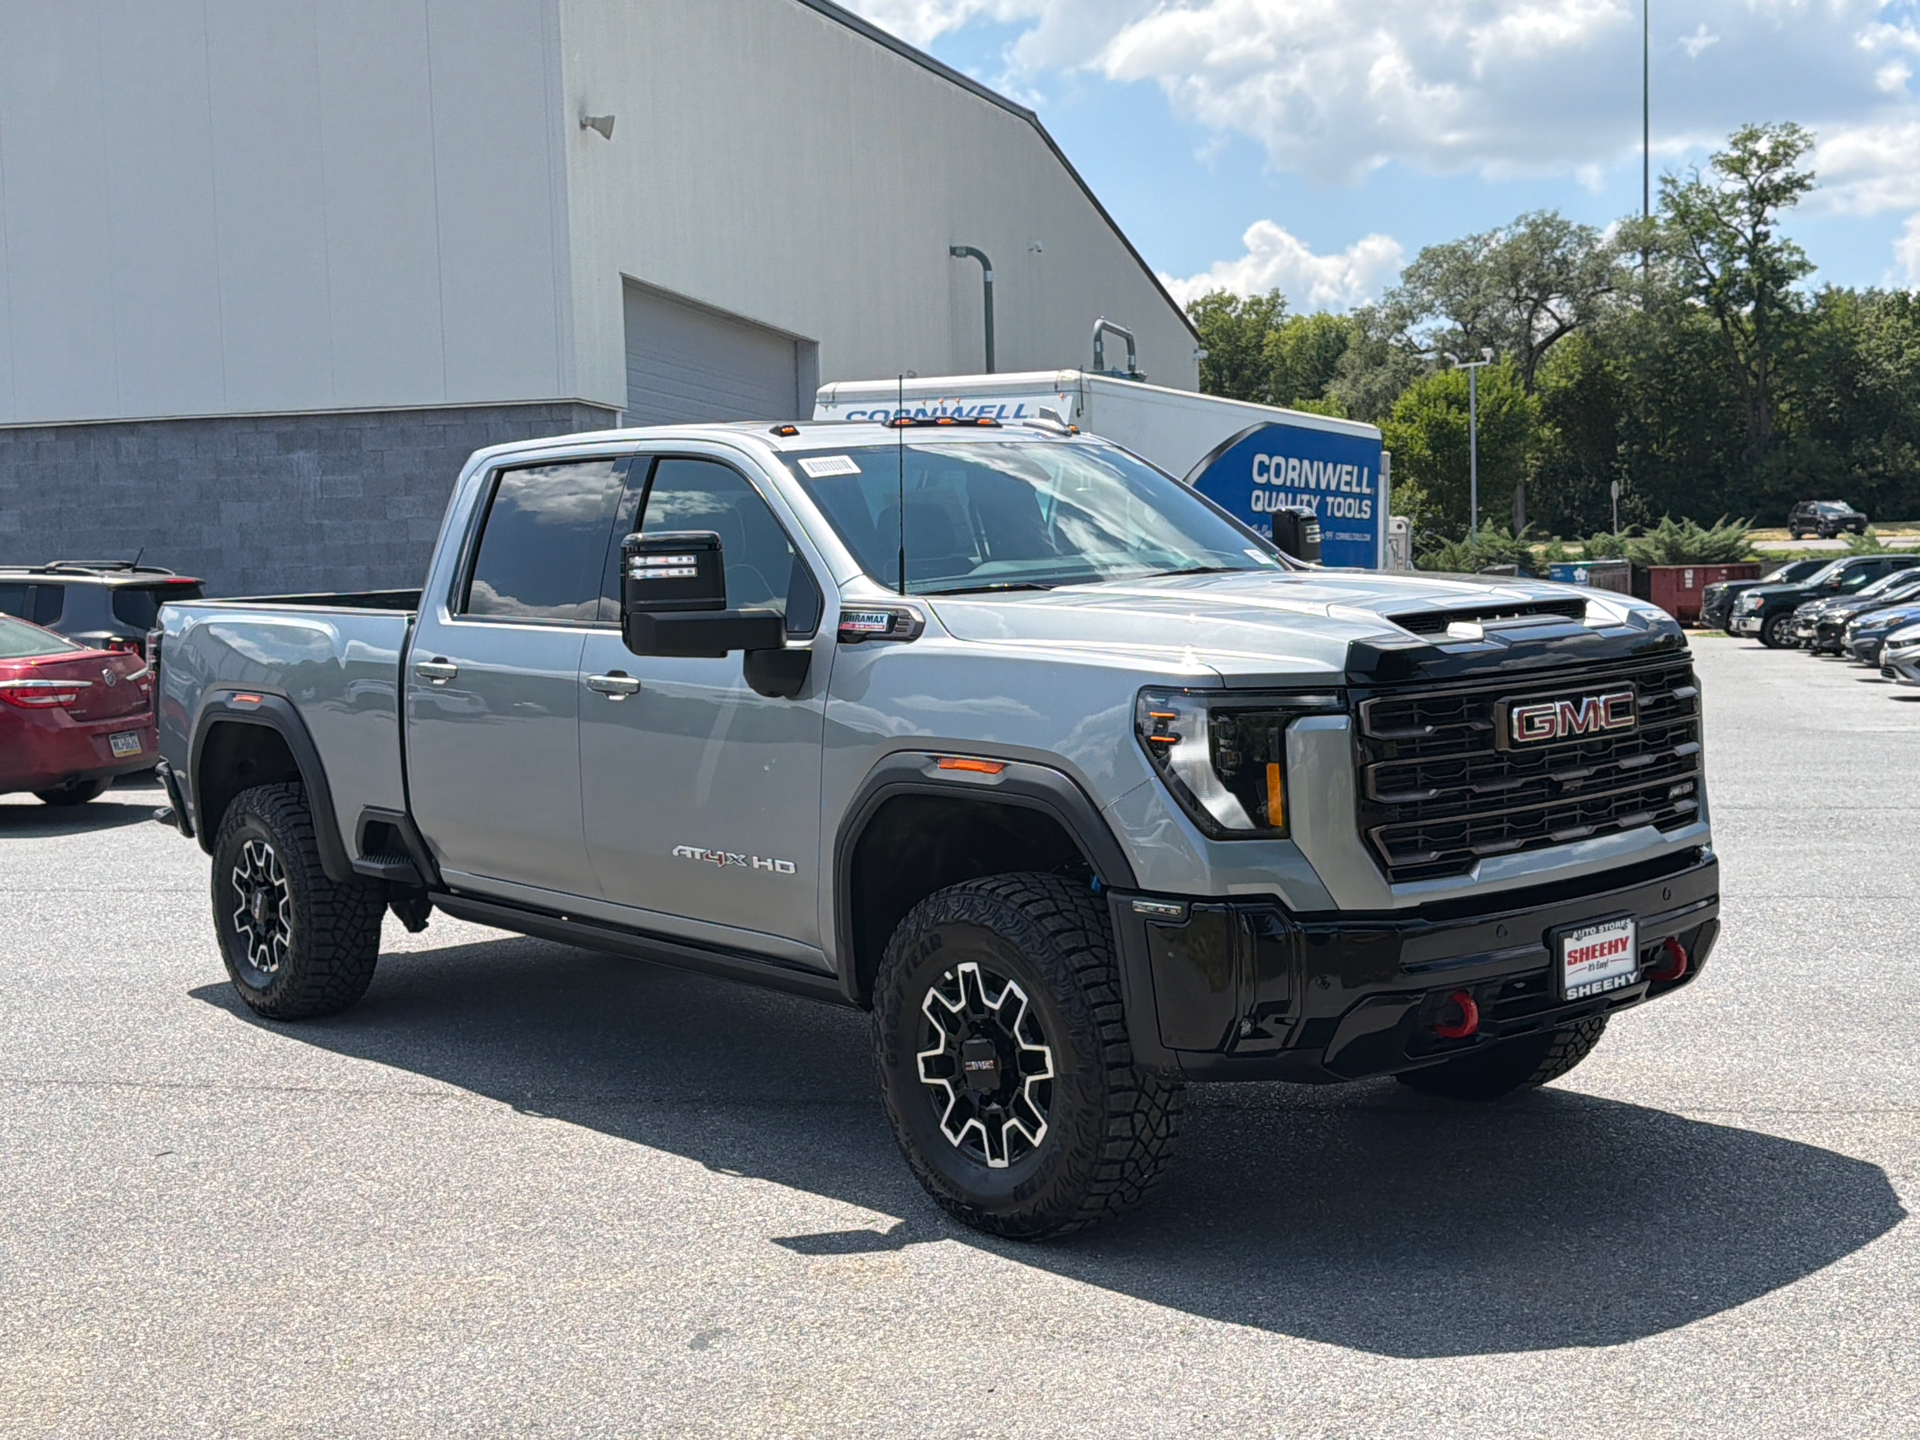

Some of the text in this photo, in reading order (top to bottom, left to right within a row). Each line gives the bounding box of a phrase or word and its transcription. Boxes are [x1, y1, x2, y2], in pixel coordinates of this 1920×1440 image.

[1252, 453, 1371, 494] CORNWELL
[1251, 489, 1372, 519] QUALITY TOOLS
[843, 613, 885, 624] DURAMAX
[1512, 691, 1635, 742] GMC
[672, 845, 796, 874] AT4X HD
[1572, 918, 1632, 939] AUTO STORES
[1567, 935, 1630, 966] SHEEHY
[1566, 971, 1639, 1000] SHEEHY
